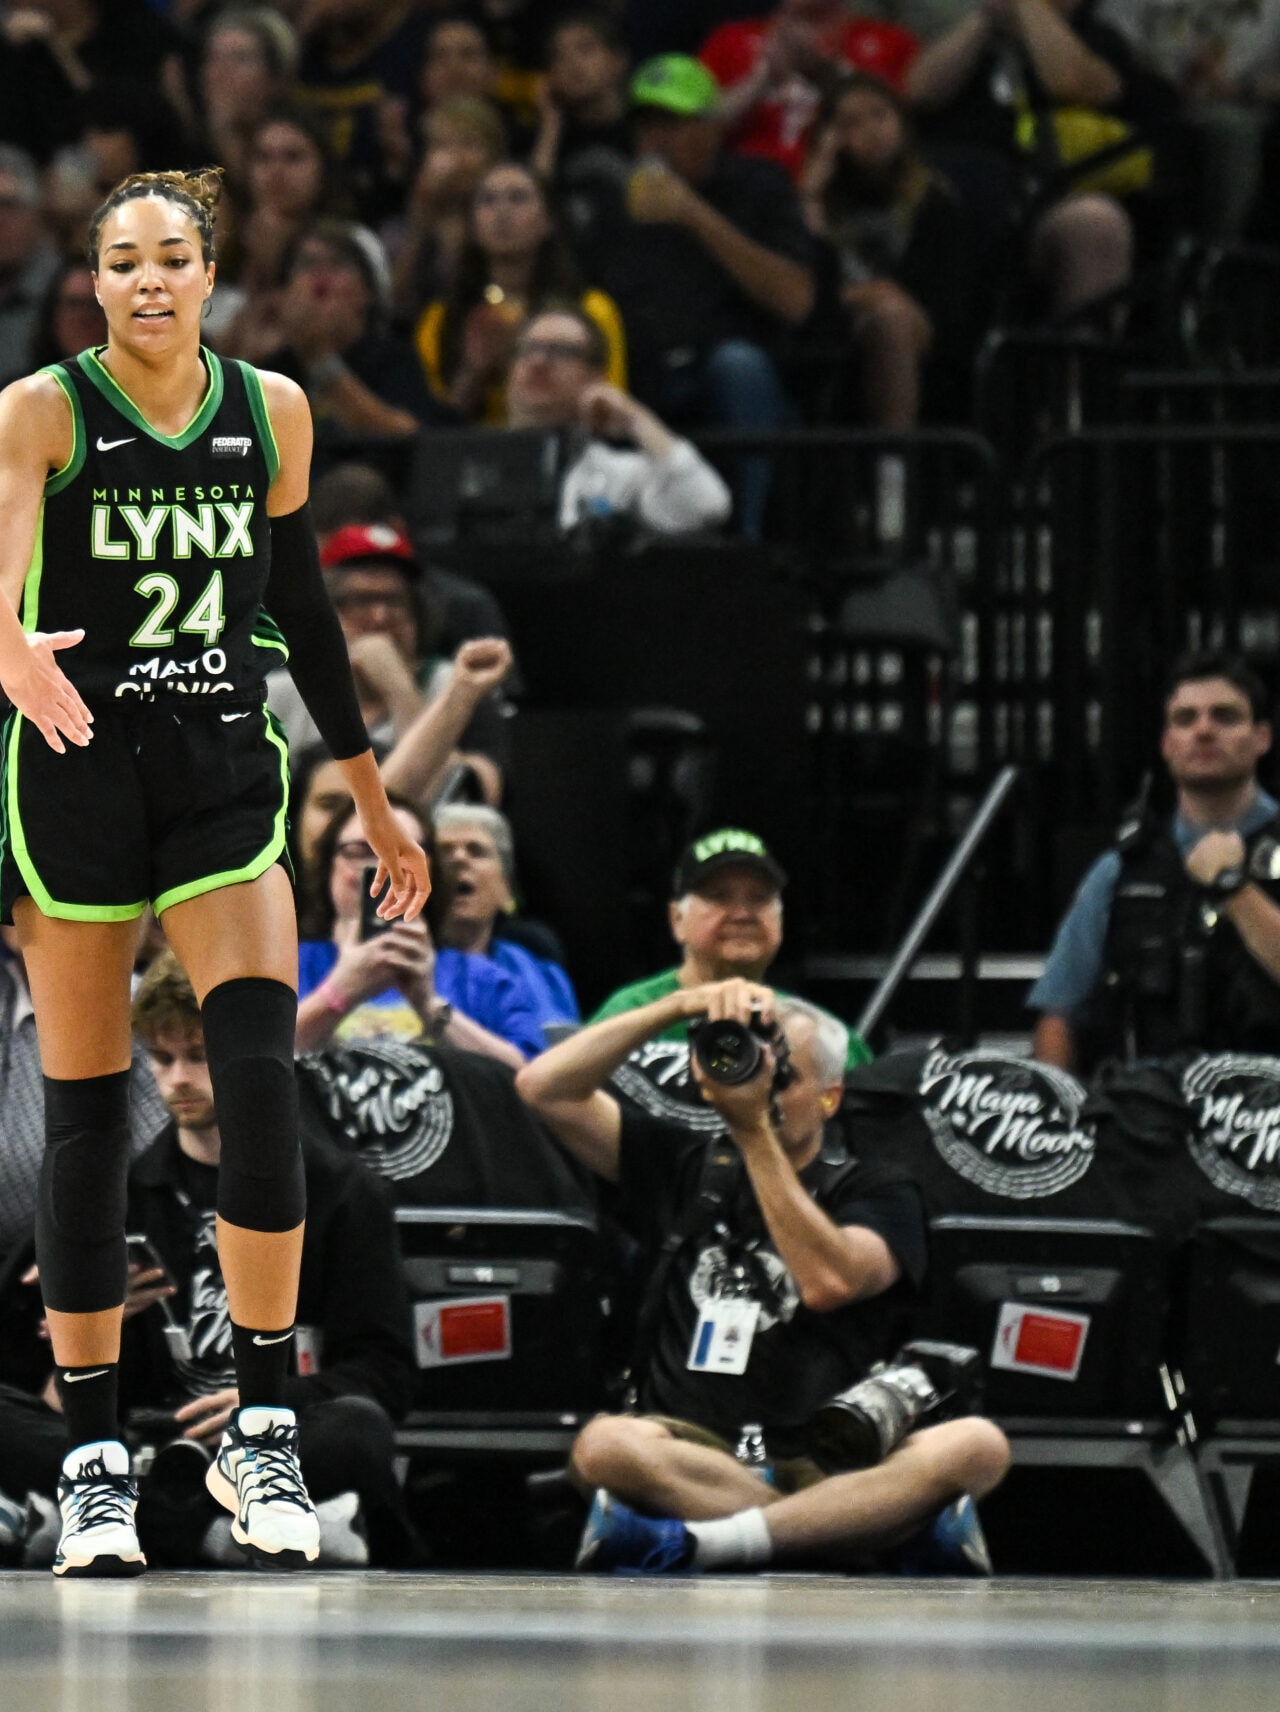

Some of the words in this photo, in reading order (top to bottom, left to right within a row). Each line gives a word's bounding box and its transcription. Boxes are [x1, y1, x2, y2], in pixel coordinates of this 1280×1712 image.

[92, 485, 255, 502] MINNESOTA
[91, 502, 255, 561] LYNX
[128, 570, 226, 648] 24
